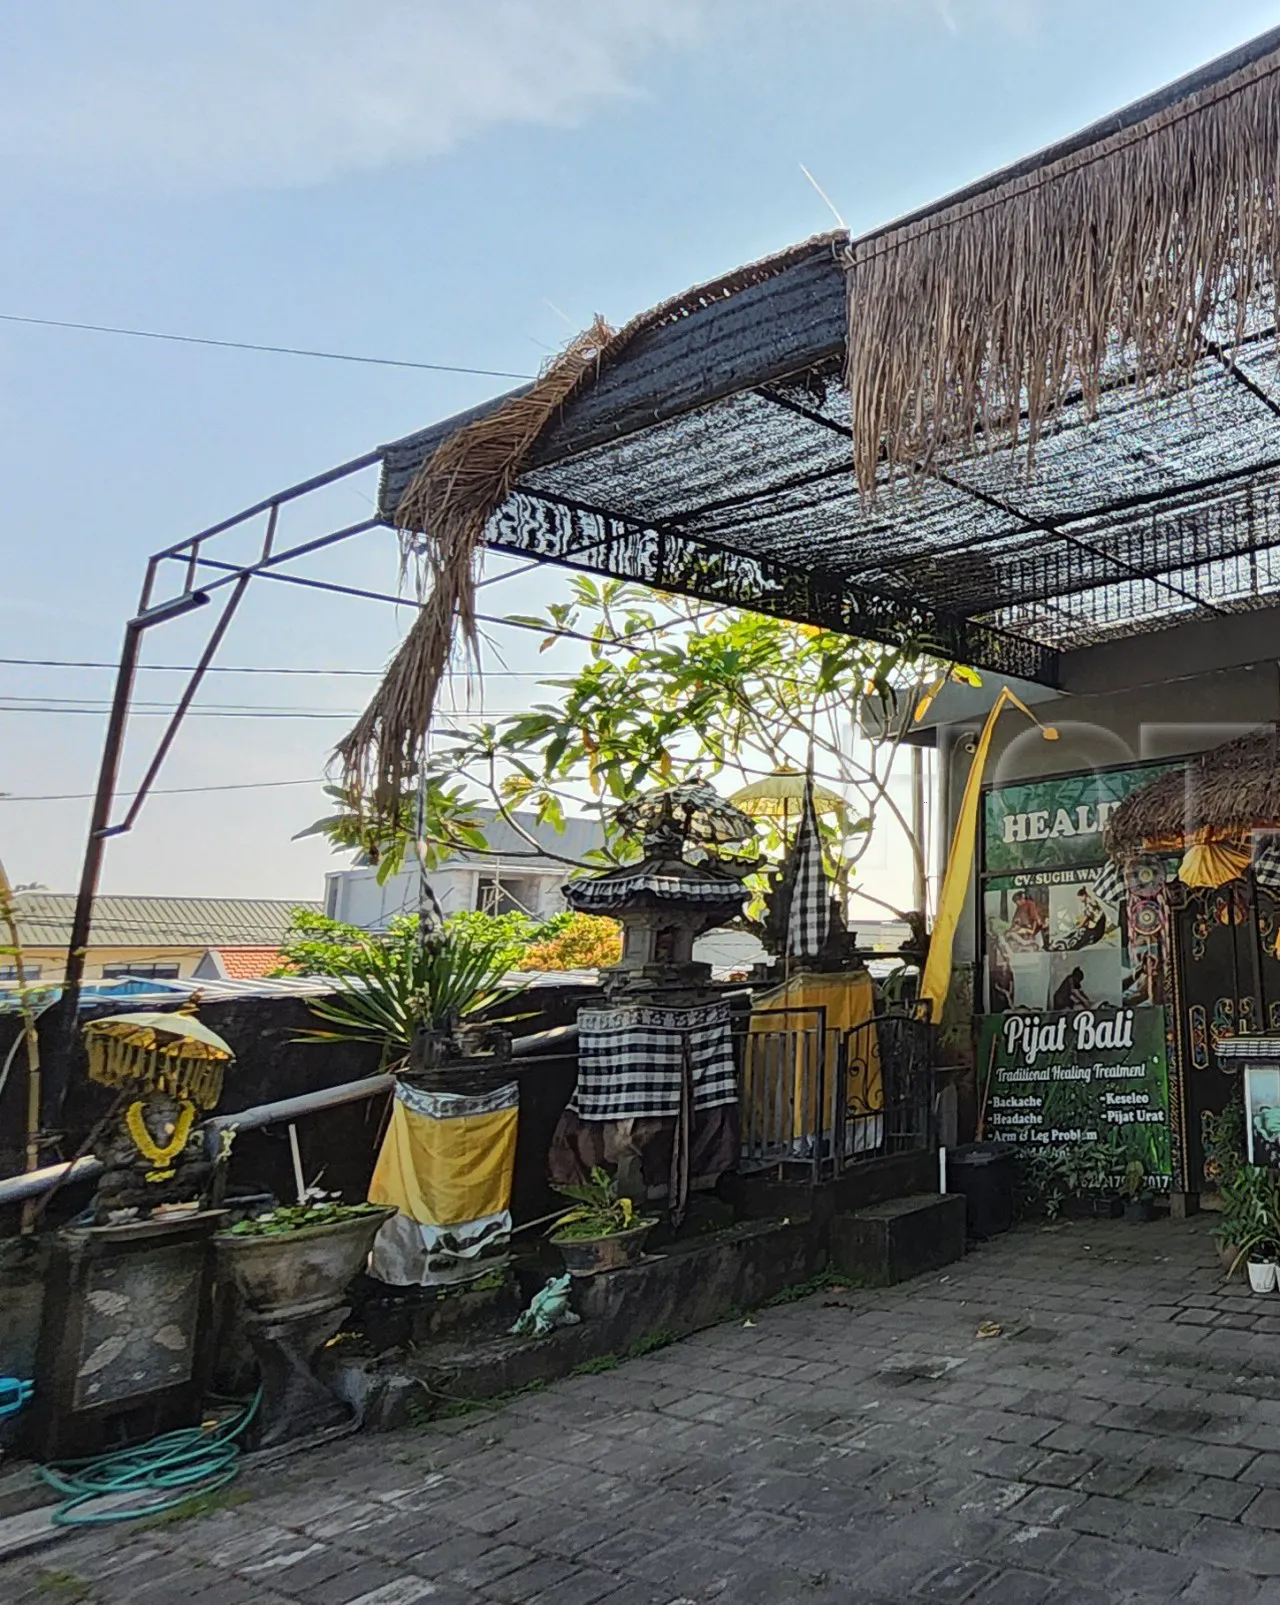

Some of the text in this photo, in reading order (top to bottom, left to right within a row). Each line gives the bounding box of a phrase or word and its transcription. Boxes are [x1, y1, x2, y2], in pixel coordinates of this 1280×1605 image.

[1014, 873, 1034, 887] CV.
[1036, 870, 1075, 885] SUGIH
[1004, 1009, 1134, 1064] Pijat Bali
[996, 1063, 1146, 1083] Traditional Healing Treatment
[1137, 1109, 1165, 1122] Urat
[1019, 1129, 1029, 1142] &
[1030, 1129, 1049, 1144] Leg
